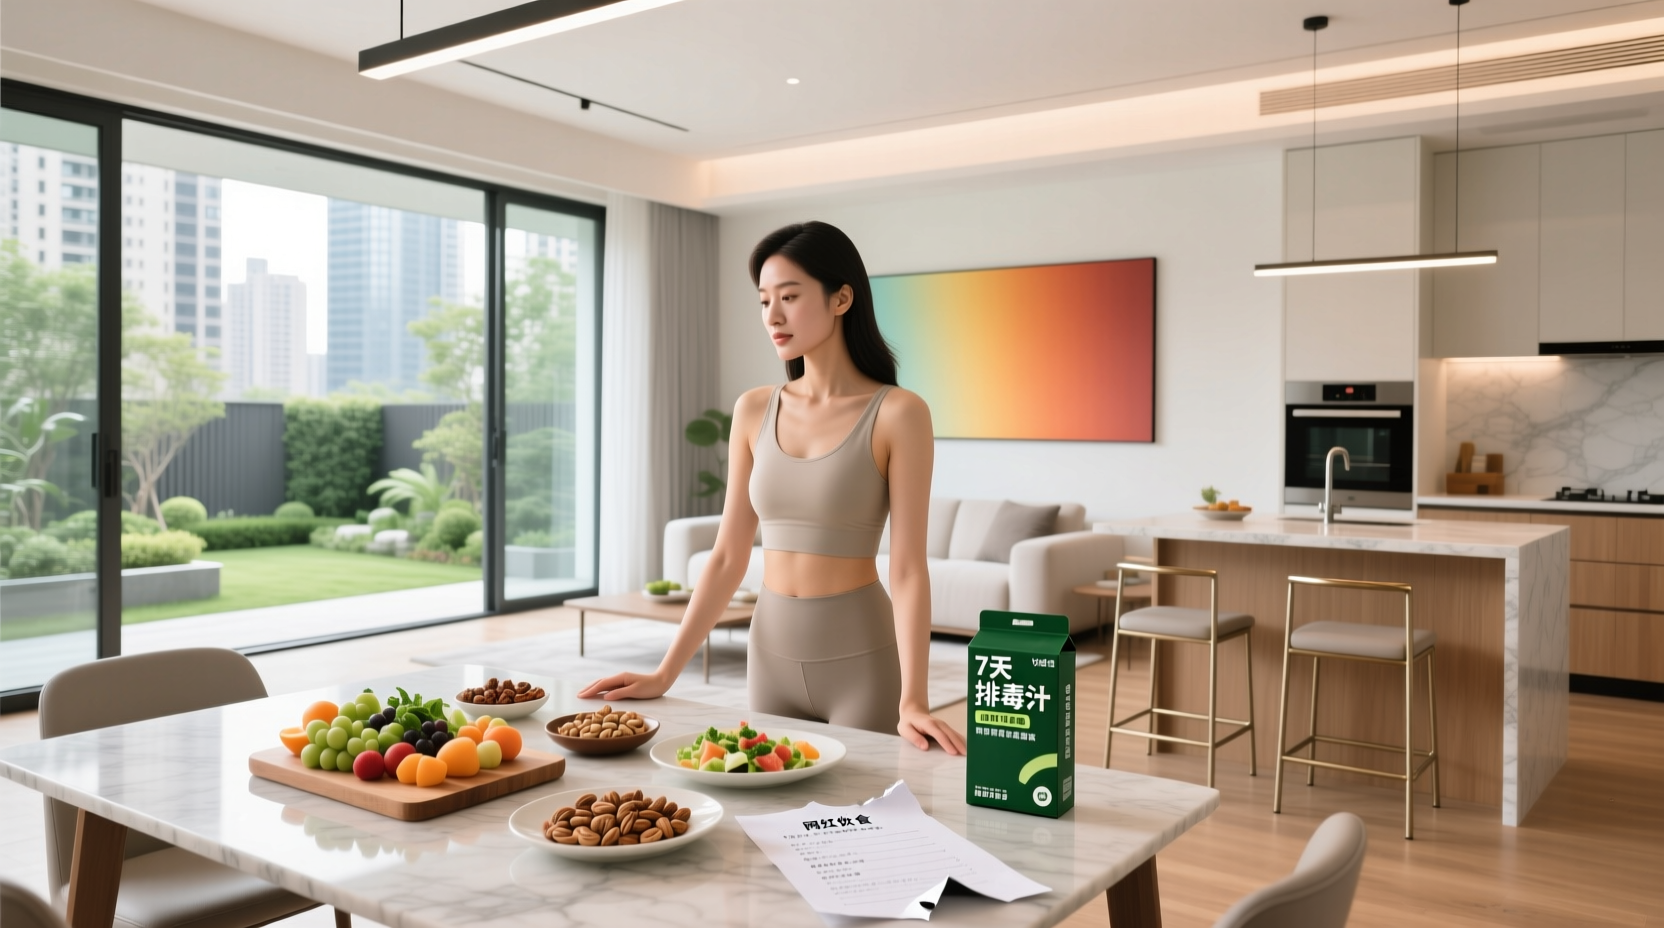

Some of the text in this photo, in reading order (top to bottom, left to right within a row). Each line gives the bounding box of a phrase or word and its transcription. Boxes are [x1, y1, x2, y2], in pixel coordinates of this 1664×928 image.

[975, 655, 1012, 680] 7天
[975, 679, 1051, 712] 排毒汁
